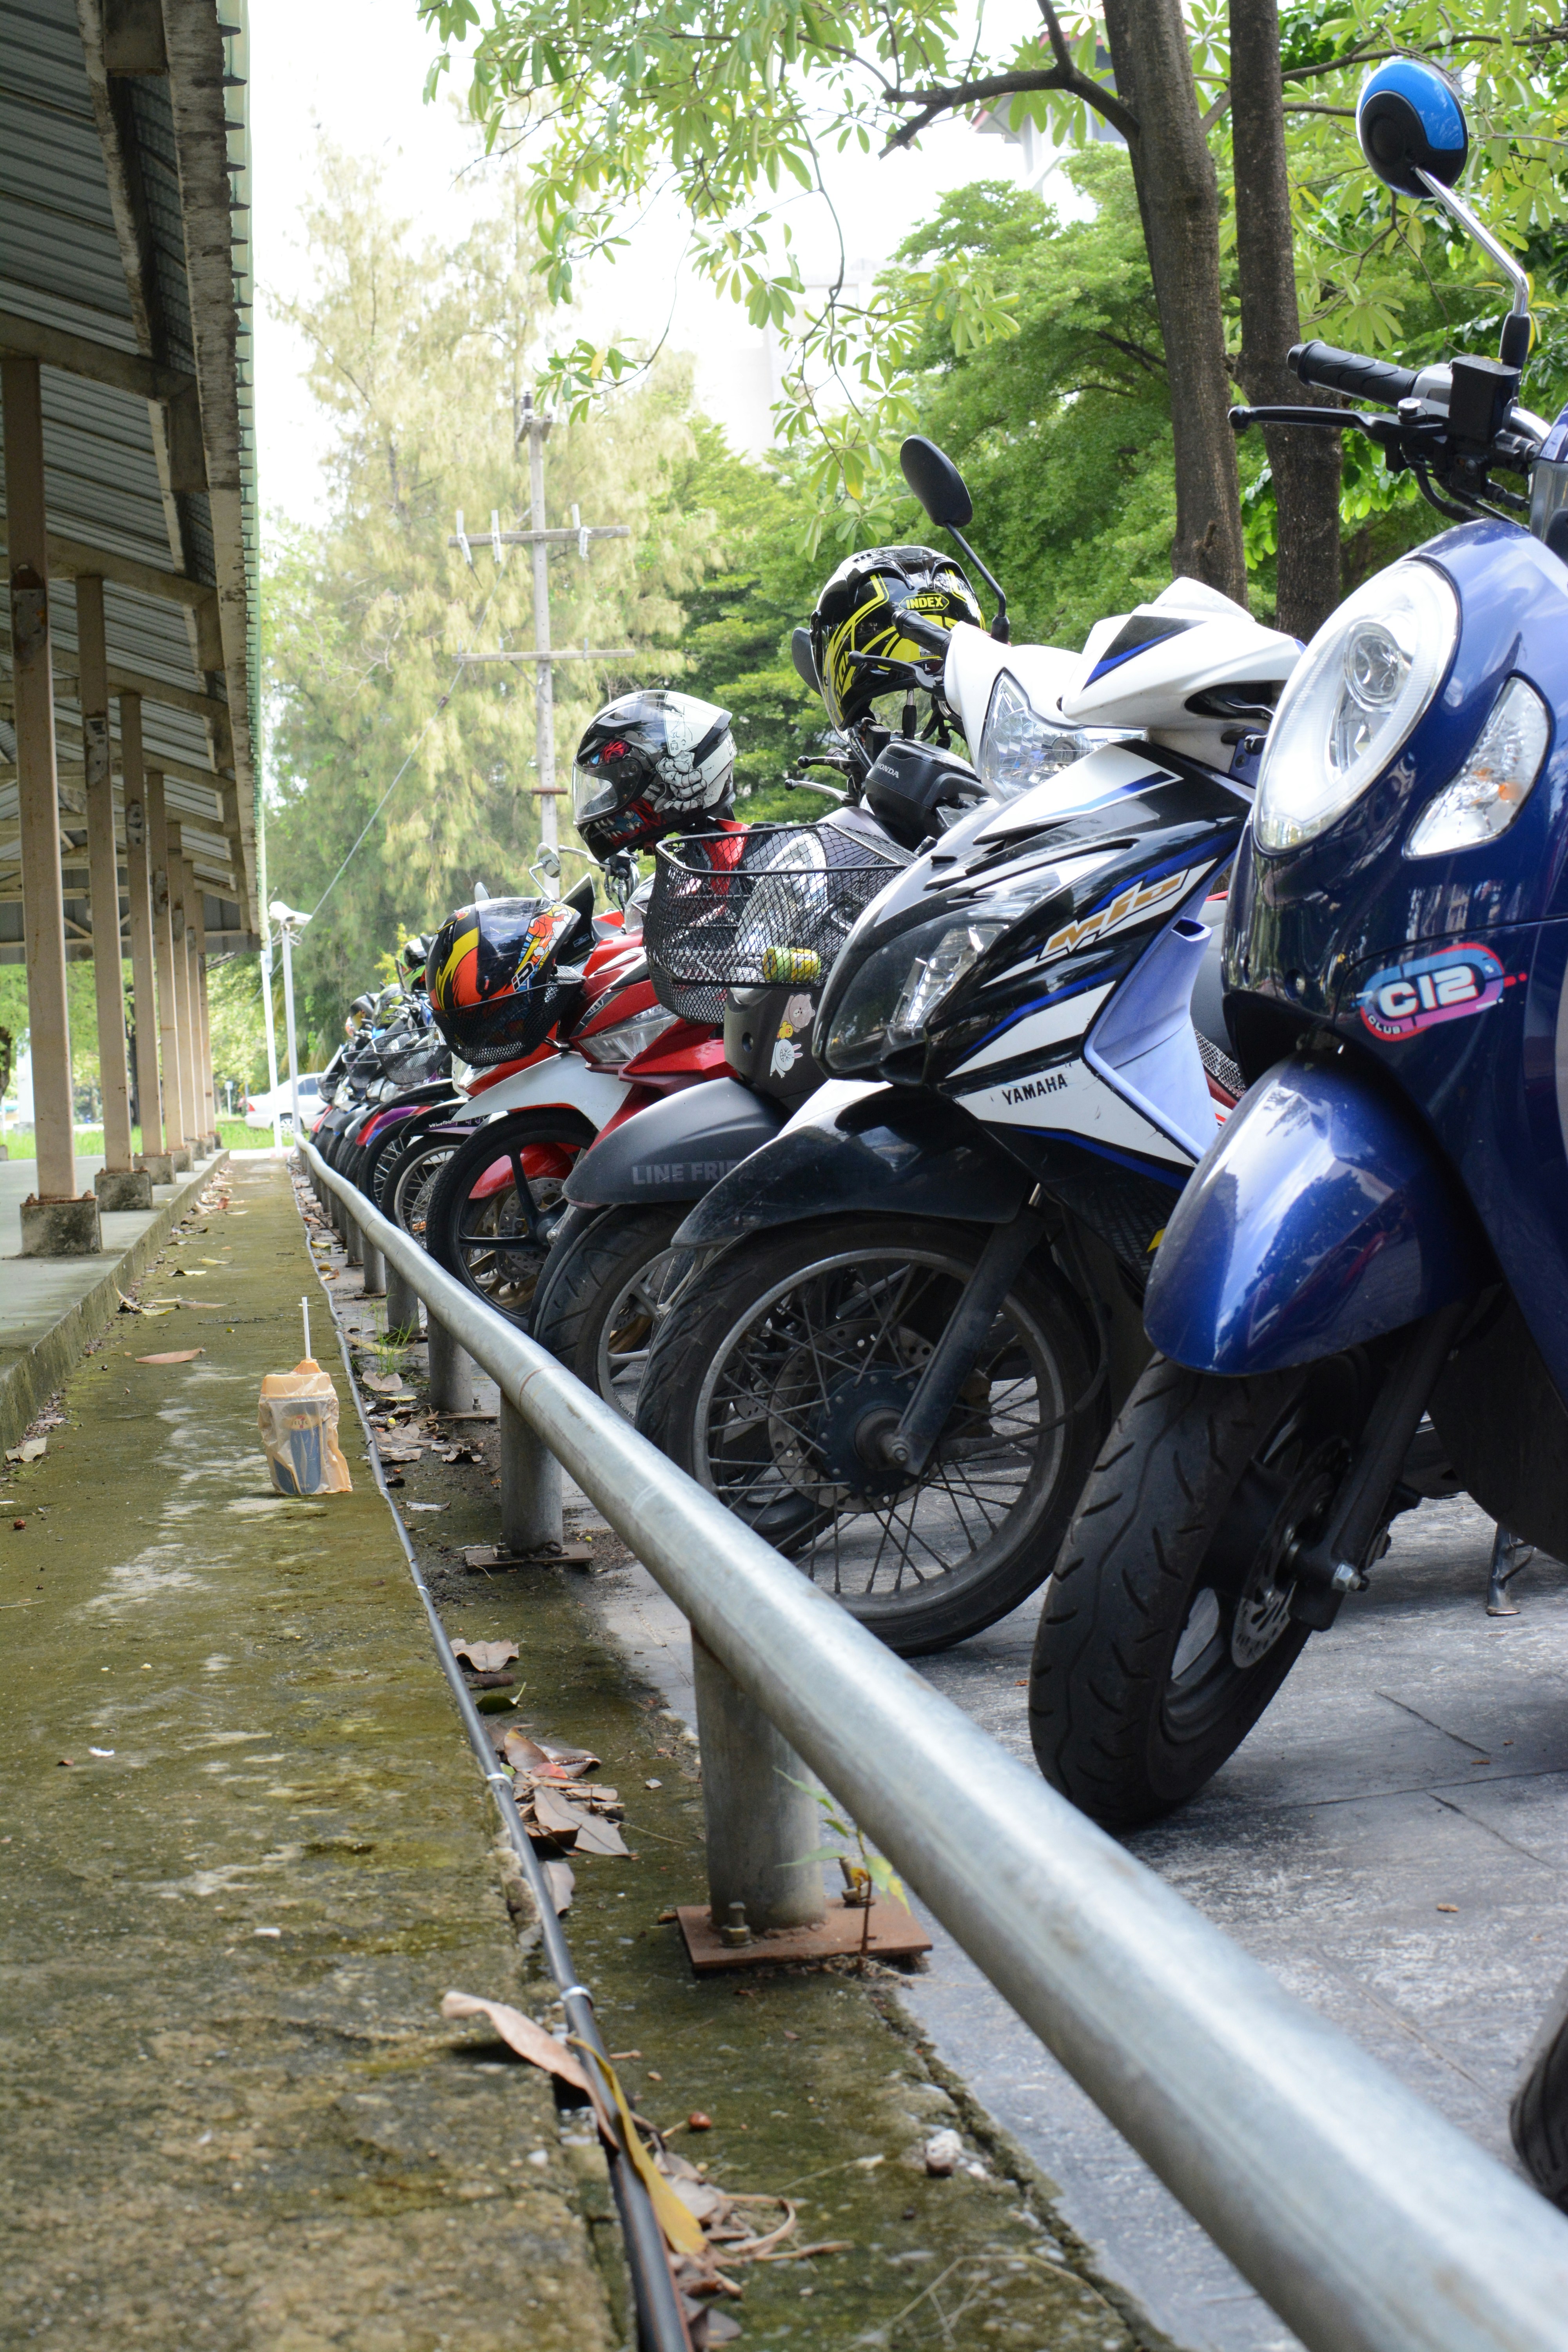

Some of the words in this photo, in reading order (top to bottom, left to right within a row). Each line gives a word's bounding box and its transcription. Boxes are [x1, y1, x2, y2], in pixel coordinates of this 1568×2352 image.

[906, 597, 944, 609] INDEX
[876, 762, 899, 778] HONDA
[1002, 1074, 1067, 1105] YAMAHA
[633, 1163, 684, 1184] LINE
